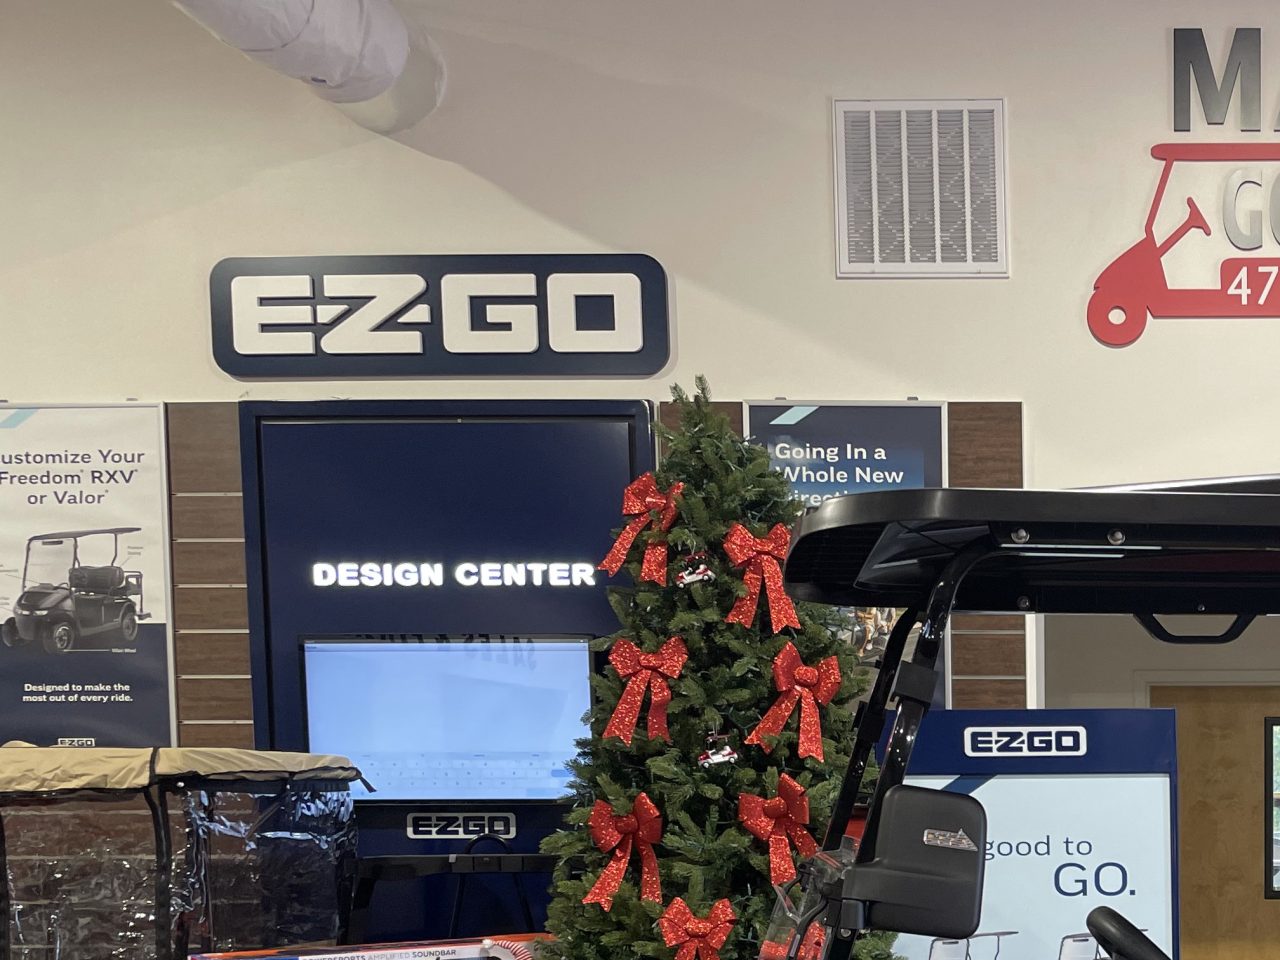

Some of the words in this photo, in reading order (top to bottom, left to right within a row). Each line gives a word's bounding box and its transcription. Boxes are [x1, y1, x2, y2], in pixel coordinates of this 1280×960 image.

[1, 450, 92, 465] ustomize
[98, 449, 145, 464] Your
[774, 442, 840, 463] Going
[846, 443, 867, 460] In
[873, 447, 887, 460] a
[774, 465, 848, 483] Whole
[855, 466, 904, 484] New
[27, 493, 47, 505] or
[312, 562, 444, 587] DESIGN
[454, 562, 596, 587] CENTER
[24, 683, 70, 693] Designed
[71, 683, 82, 692] to
[84, 683, 112, 692] make
[113, 683, 131, 692] the
[22, 694, 48, 702] most
[49, 694, 66, 702] out
[67, 693, 78, 702] of
[80, 694, 109, 703] every
[110, 693, 134, 702] ride.
[984, 834, 1051, 862] good
[1063, 836, 1093, 856] to
[1053, 861, 1137, 897] GO.
[411, 949, 457, 959] SOUNDBAR
